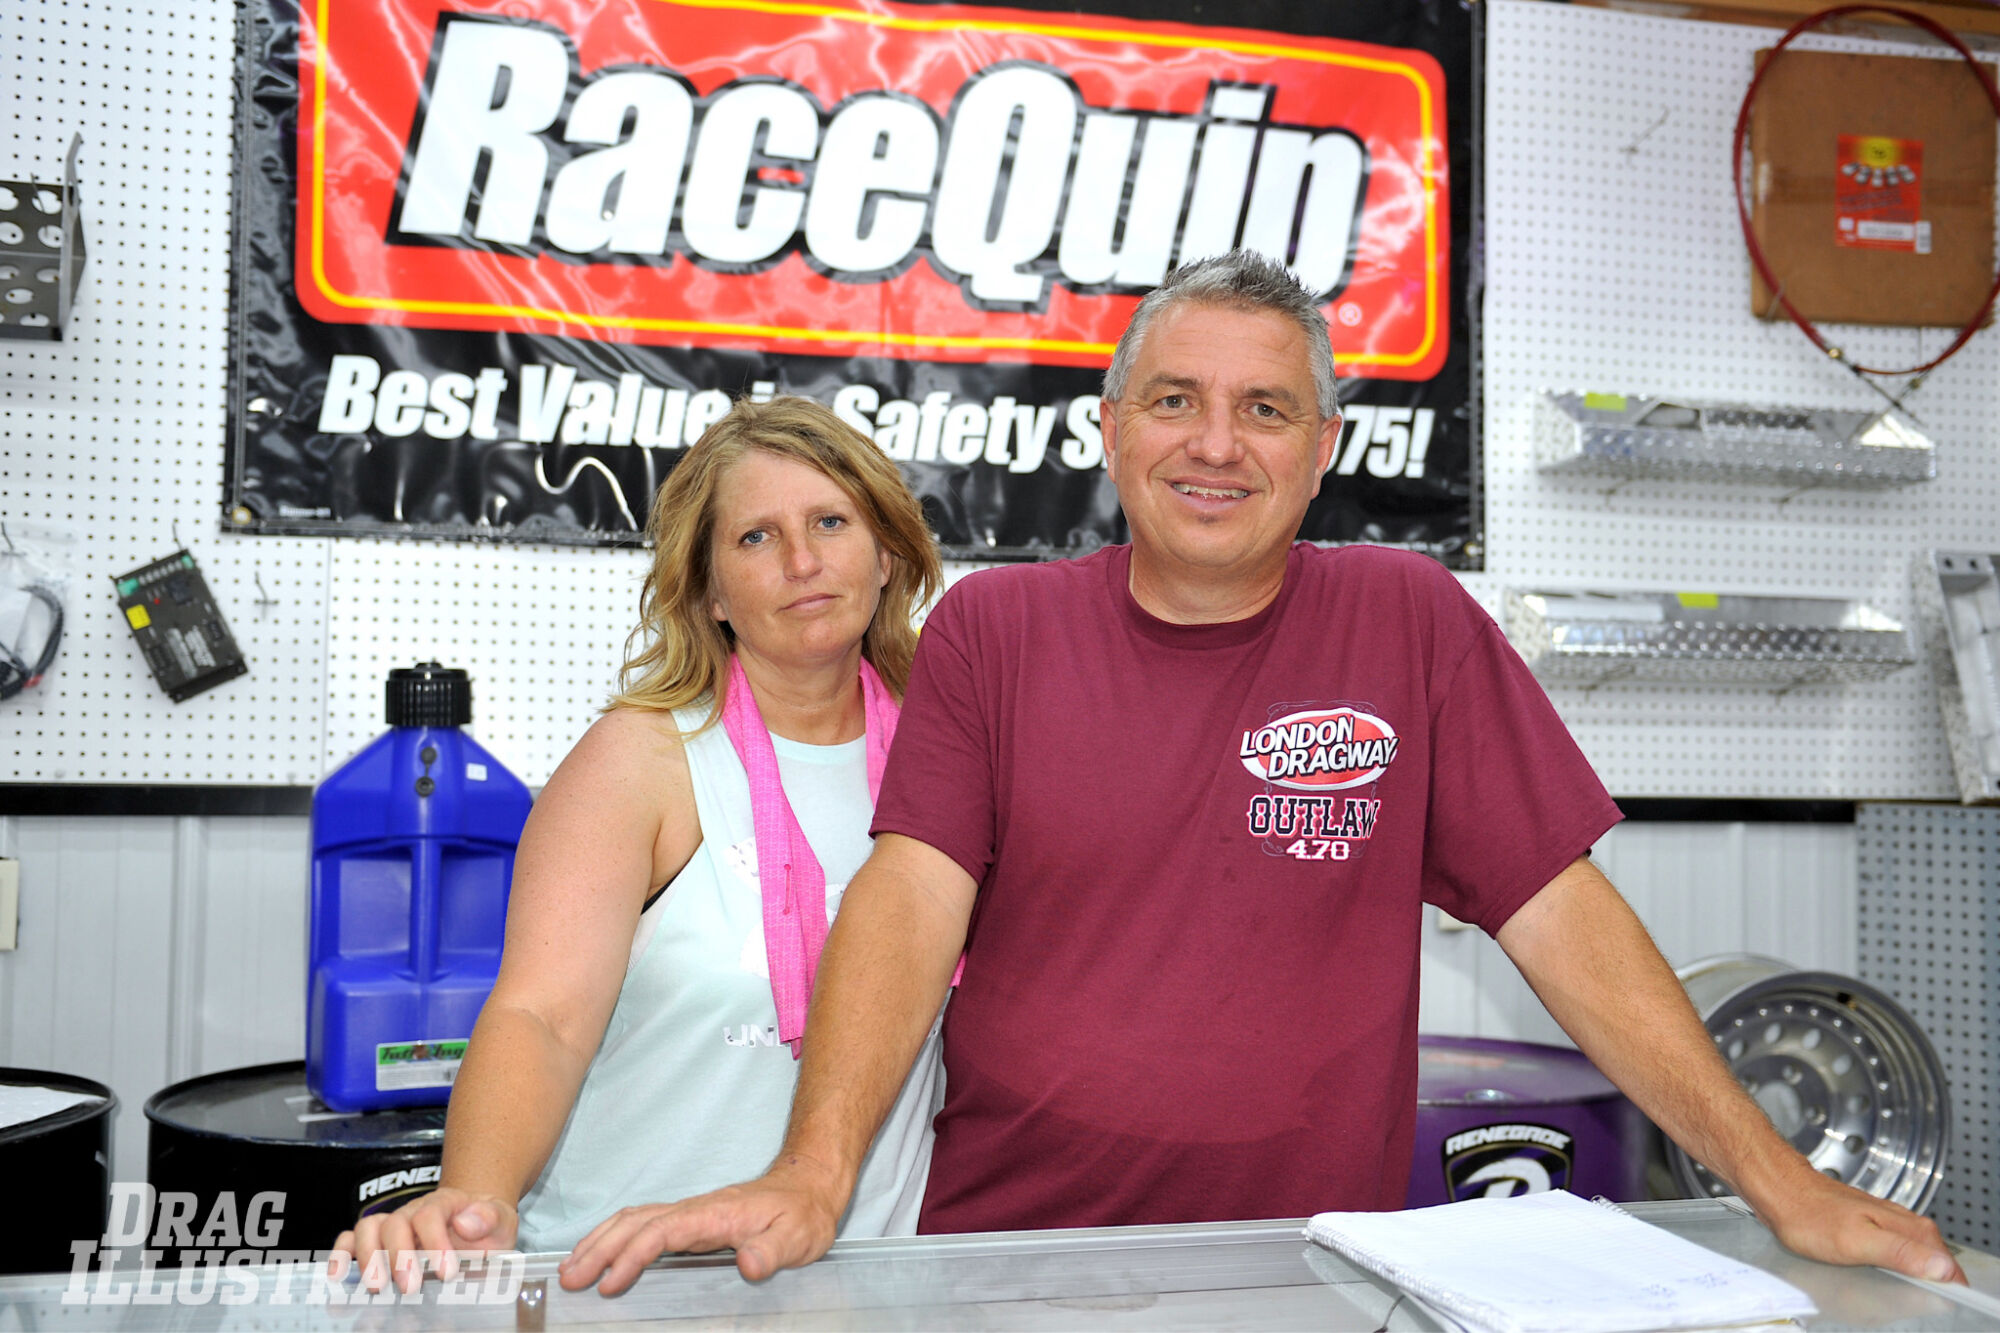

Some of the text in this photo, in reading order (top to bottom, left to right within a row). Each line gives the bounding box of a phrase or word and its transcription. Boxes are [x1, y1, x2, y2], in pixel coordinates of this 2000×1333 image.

[398, 18, 1368, 302] RaceQuip
[318, 354, 506, 441] Best
[519, 364, 733, 449] Value
[833, 384, 1056, 474] Safety
[1326, 404, 1436, 479] 75!
[1240, 715, 1355, 758] LONDON
[1267, 737, 1399, 780] DRAGWAY
[1247, 795, 1381, 838] OUTLAW
[1445, 1124, 1572, 1156] RENEGADE
[359, 1165, 442, 1202] RENE
